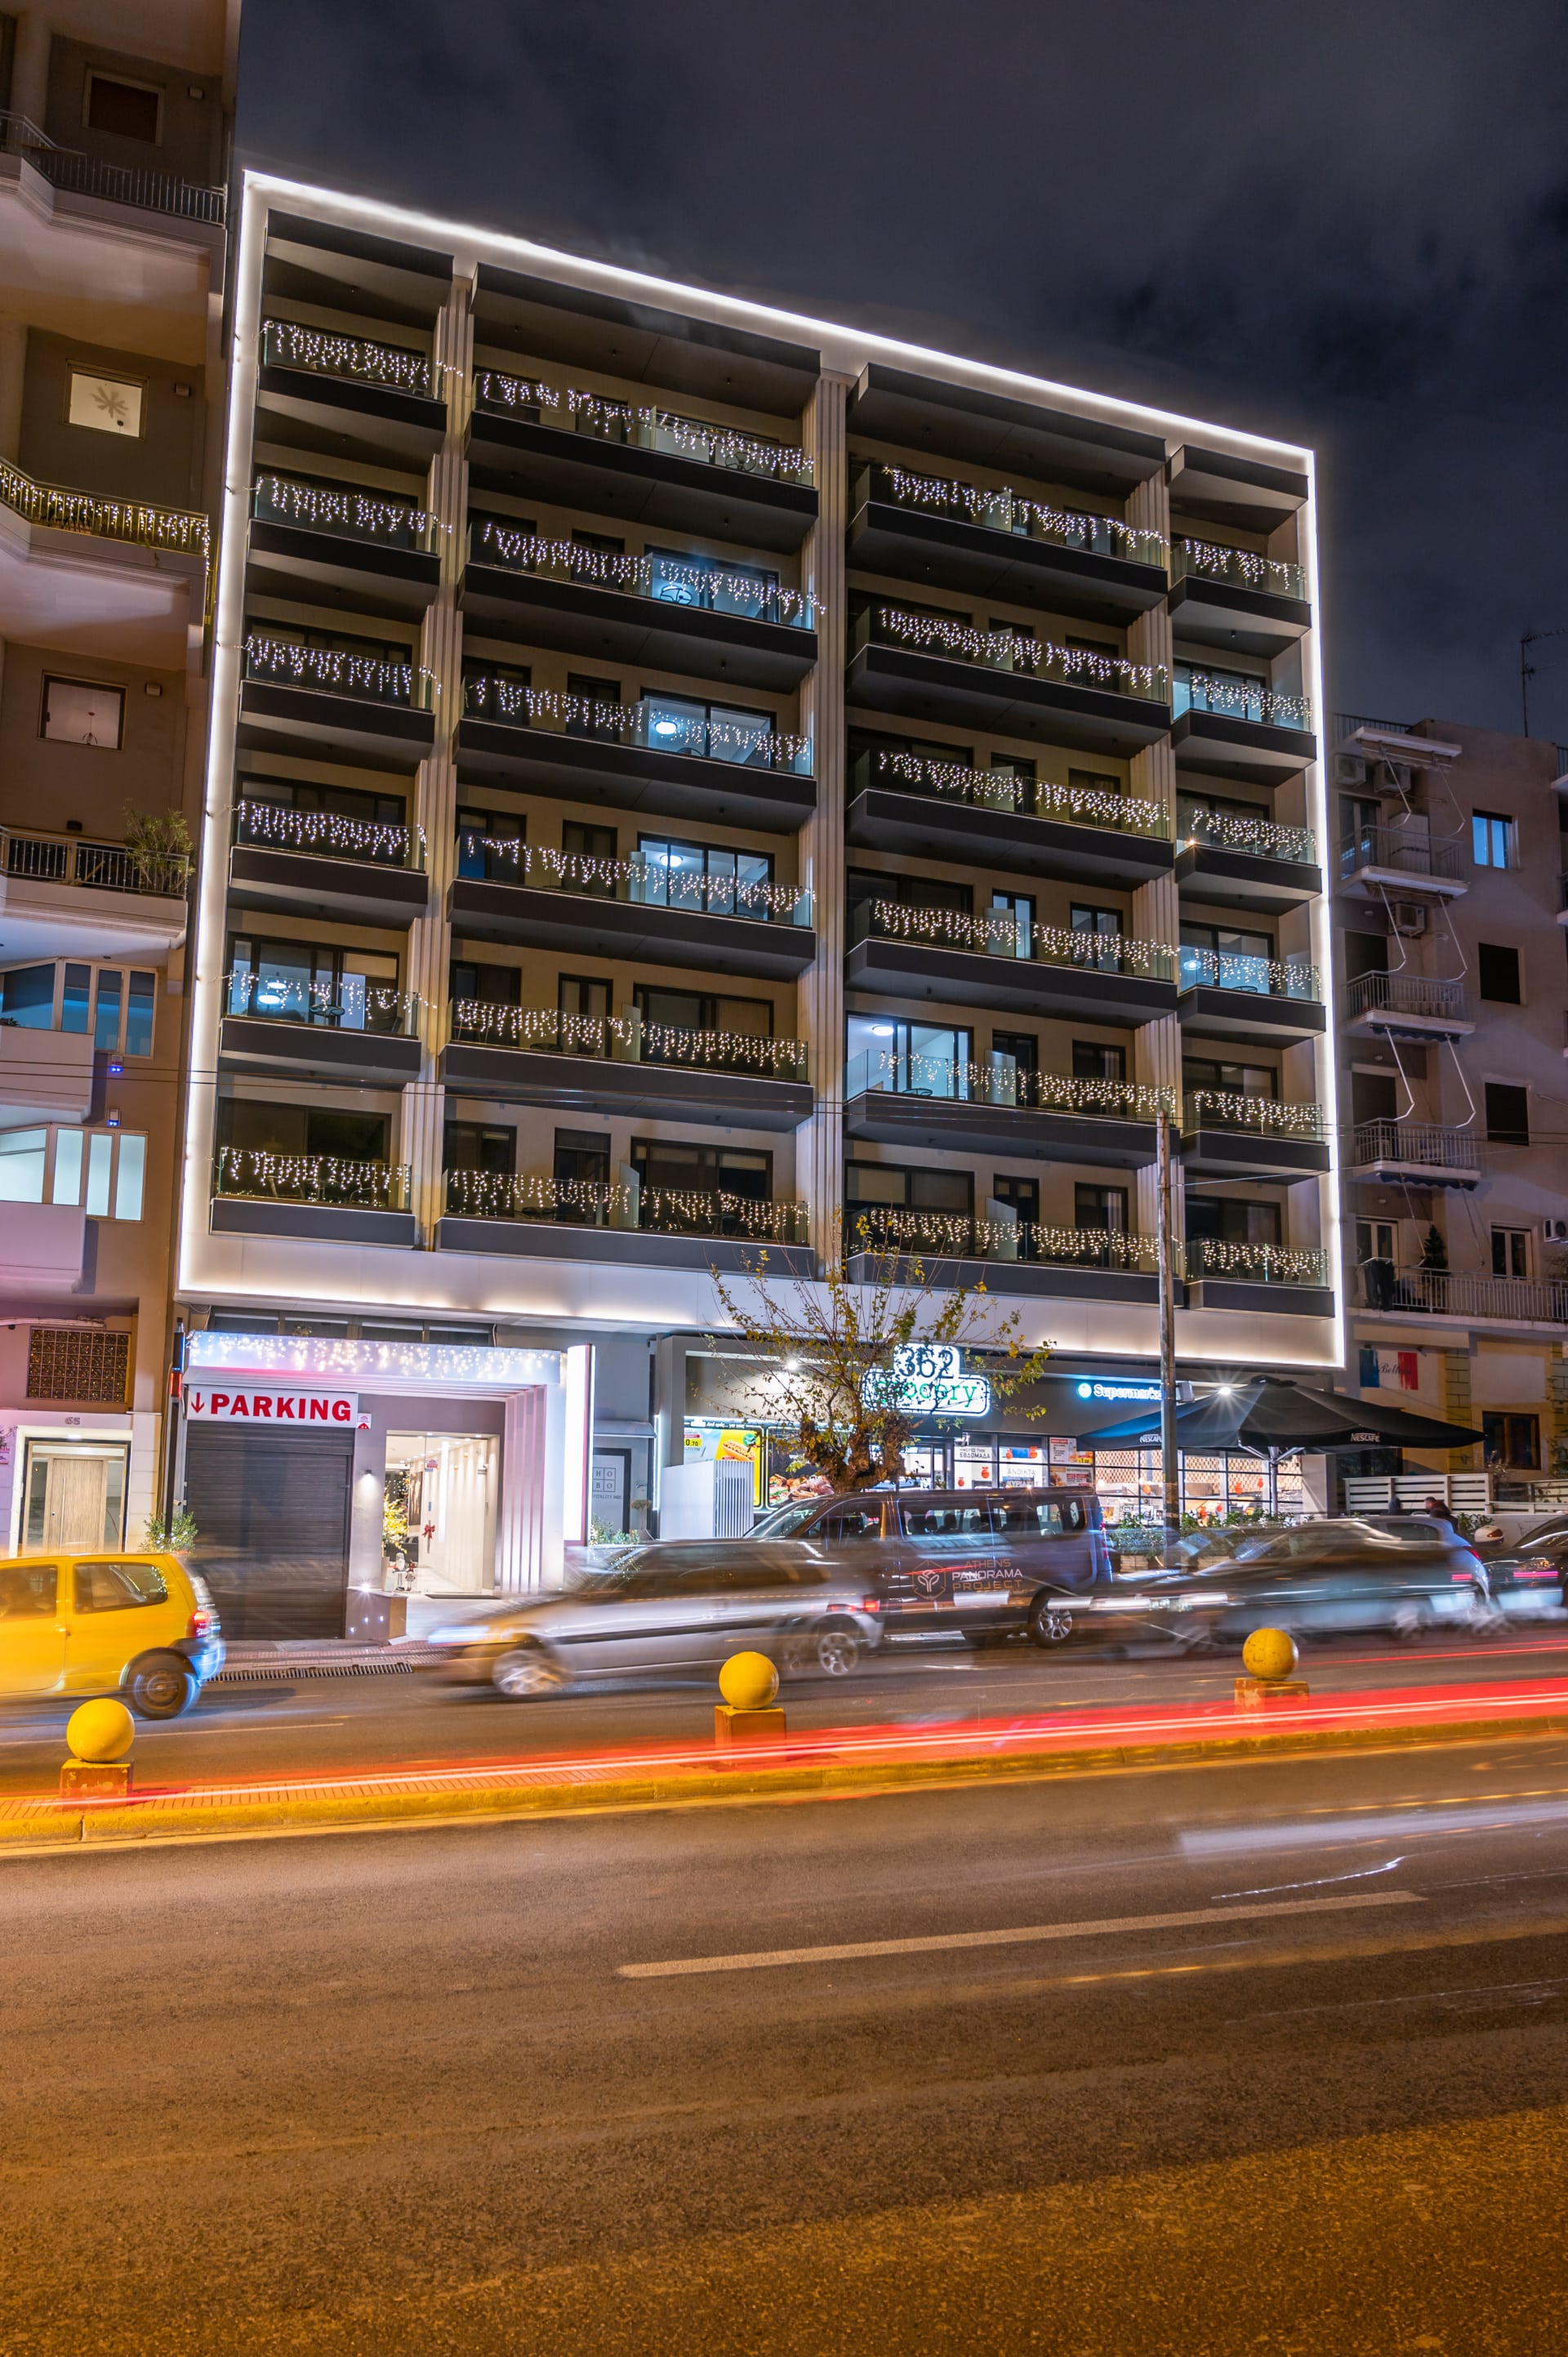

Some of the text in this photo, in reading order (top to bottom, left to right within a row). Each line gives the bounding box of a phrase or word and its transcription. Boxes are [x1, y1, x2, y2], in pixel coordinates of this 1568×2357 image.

[898, 1347, 954, 1379] 362
[875, 1379, 978, 1408] ocery
[1094, 1383, 1163, 1401] Supermarke
[210, 1393, 351, 1422] PARKING
[65, 1416, 81, 1425] 65
[965, 1558, 1012, 1568] ATHENS
[951, 1568, 1023, 1581] PANORAMA
[953, 1580, 1022, 1591] PROJECT
